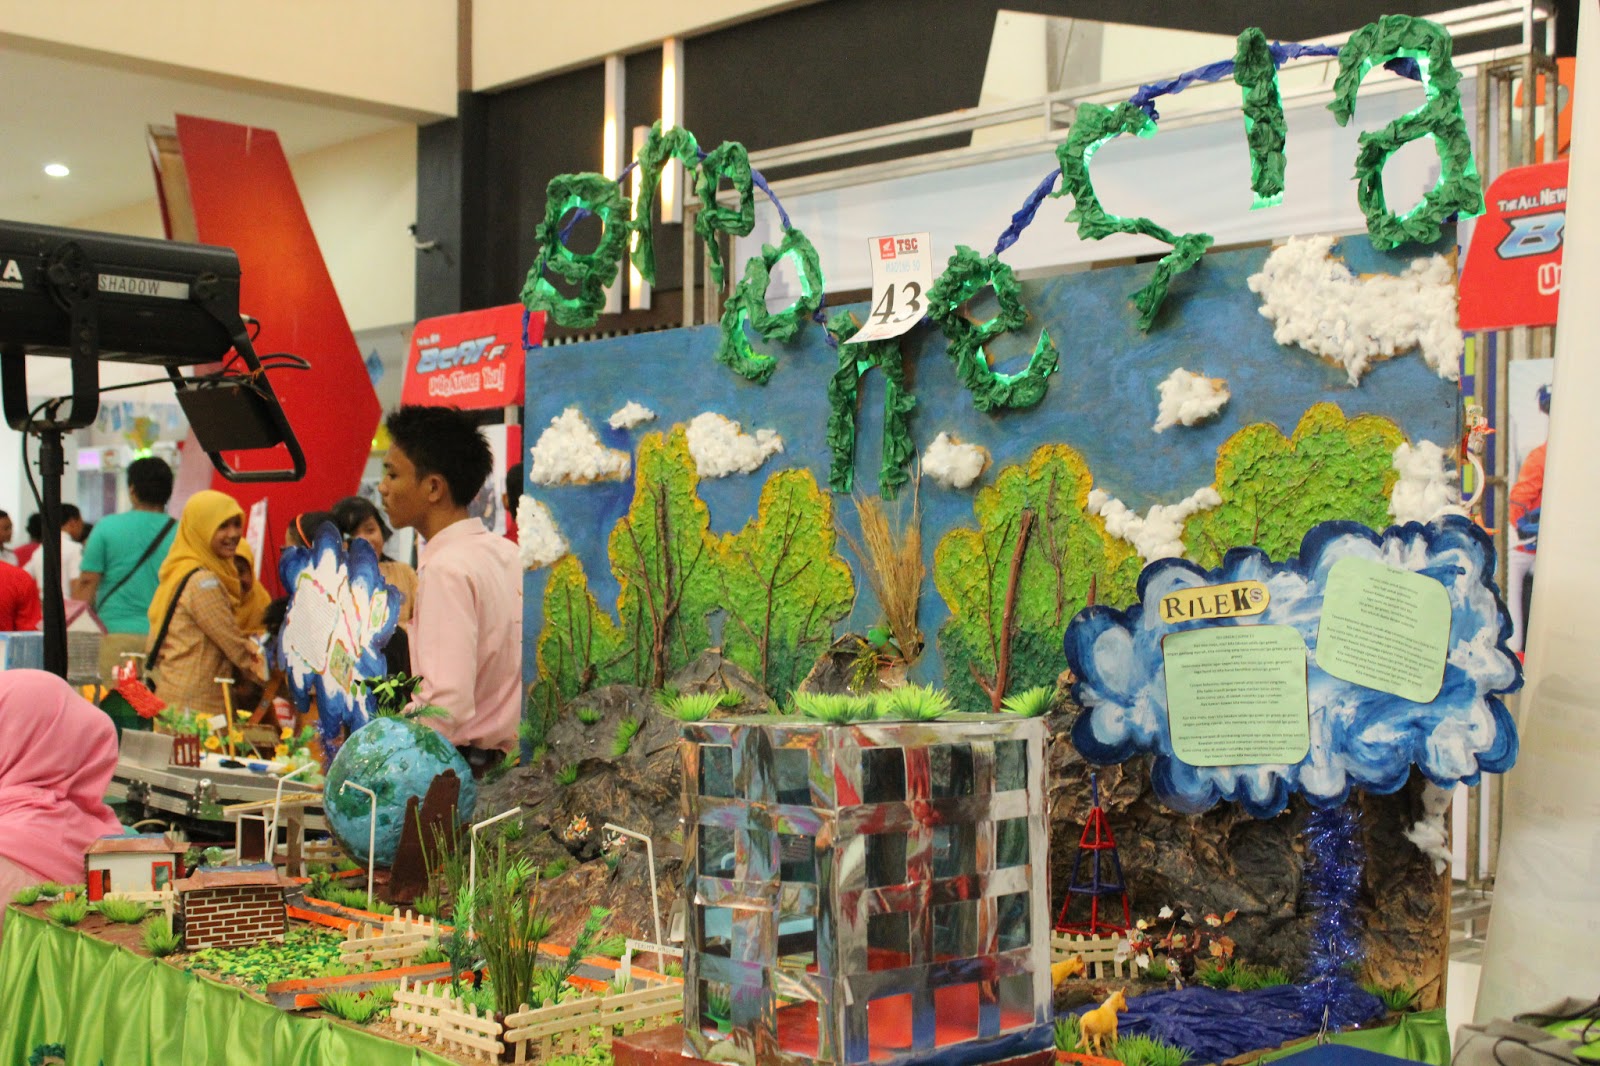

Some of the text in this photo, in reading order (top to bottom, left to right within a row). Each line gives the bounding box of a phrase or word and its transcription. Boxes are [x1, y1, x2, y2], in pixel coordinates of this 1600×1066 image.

[1518, 195, 1540, 210] ALL
[896, 238, 918, 250] TSC
[1495, 210, 1567, 260] B
[99, 274, 161, 297] SHADOW
[871, 281, 921, 326] 43
